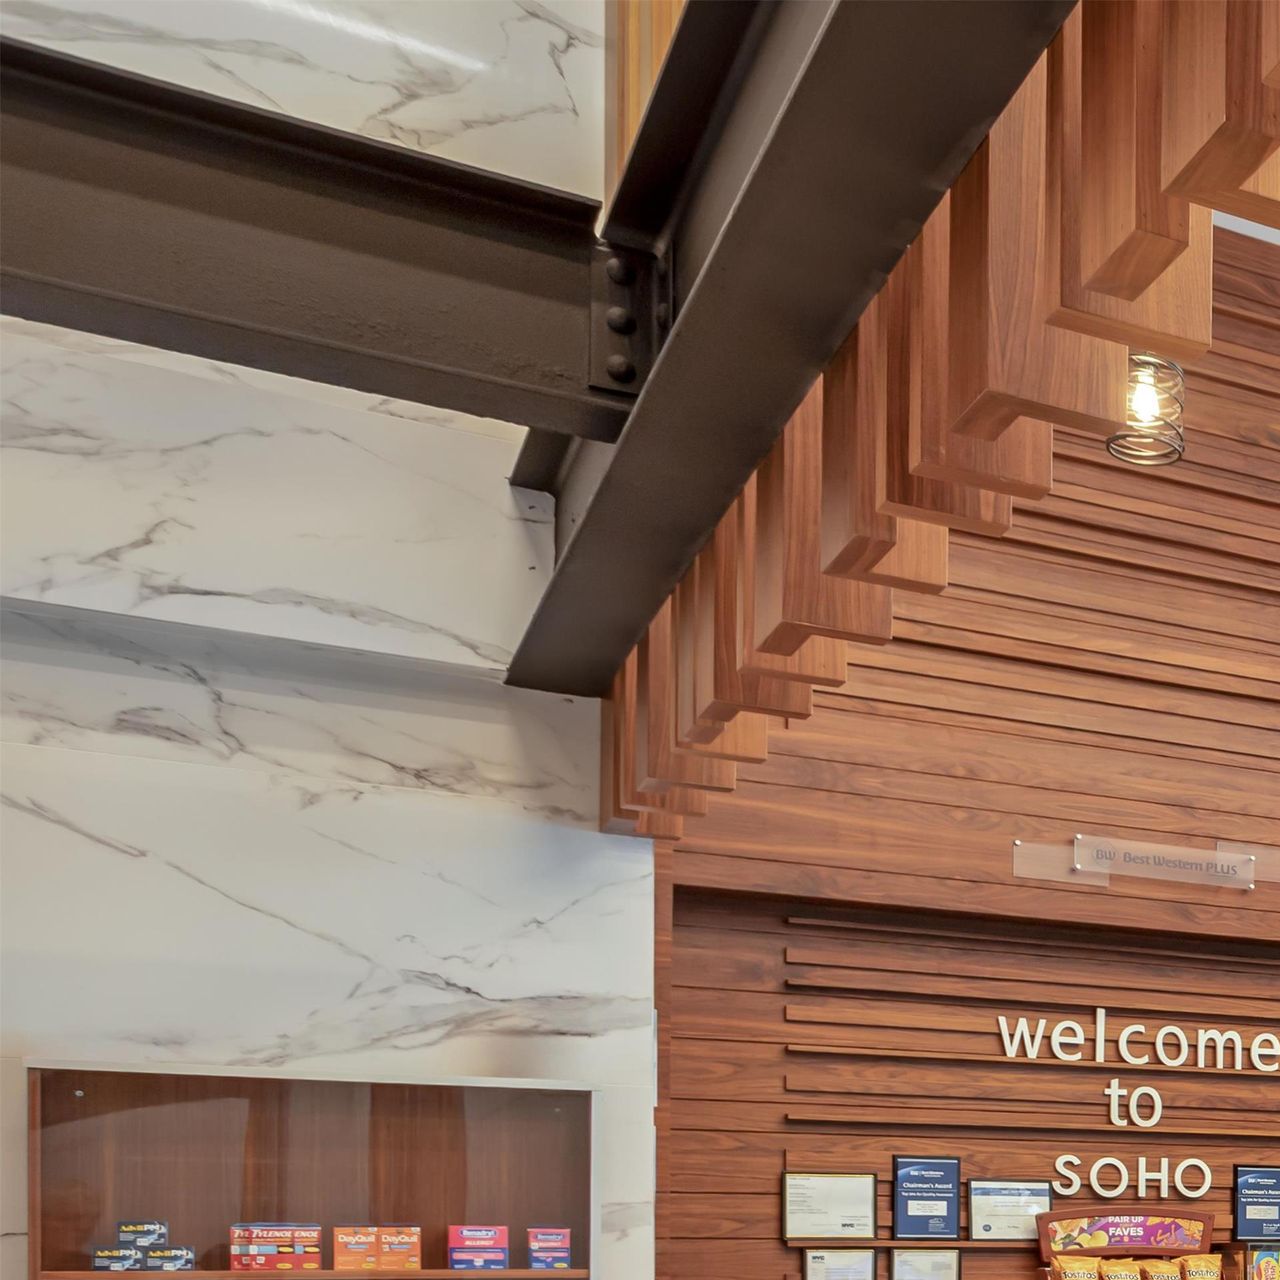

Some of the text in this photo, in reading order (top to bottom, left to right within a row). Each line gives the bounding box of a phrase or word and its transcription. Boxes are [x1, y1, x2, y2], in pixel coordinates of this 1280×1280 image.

[1095, 848, 1238, 876] BW Best Western PLUS
[1104, 1078, 1162, 1128] to
[1052, 1154, 1212, 1198] SOHO
[252, 1229, 292, 1238] TYLENOL
[295, 1230, 318, 1238] ENOL
[463, 1229, 496, 1238] Benadryl
[1108, 1227, 1144, 1236] FAVES
[338, 1234, 375, 1244] DayQuil
[382, 1234, 418, 1244] DayQuil
